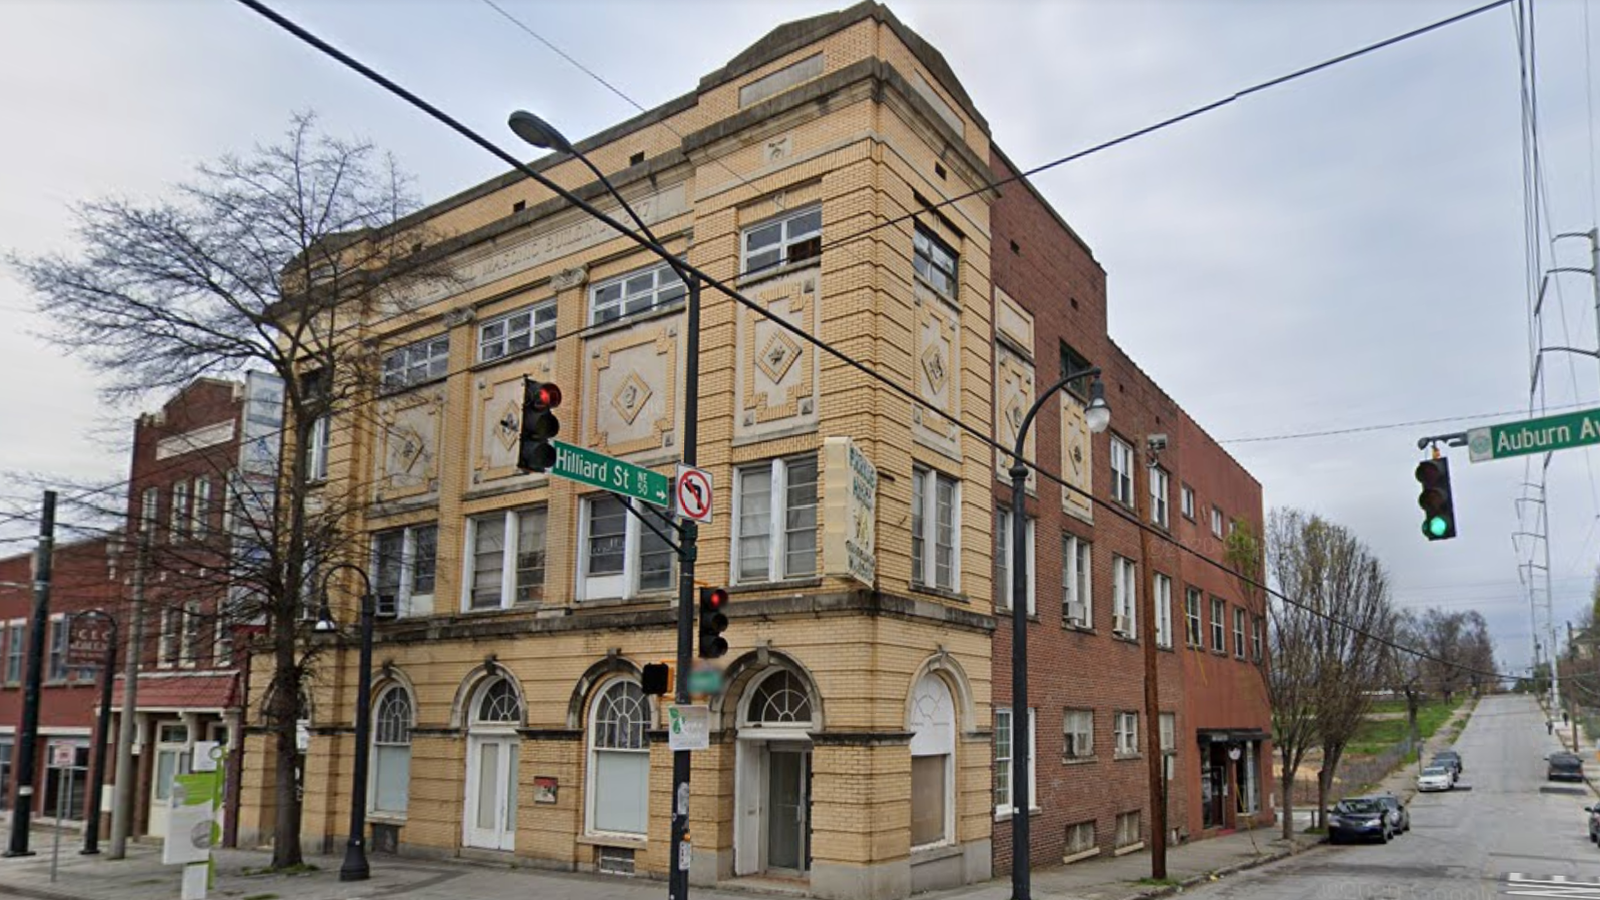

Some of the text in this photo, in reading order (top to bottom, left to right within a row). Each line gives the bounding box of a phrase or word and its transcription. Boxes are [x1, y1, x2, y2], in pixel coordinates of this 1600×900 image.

[1496, 425, 1571, 453] Auburn
[555, 447, 630, 490] Hilliard St
[637, 471, 648, 482] NE
